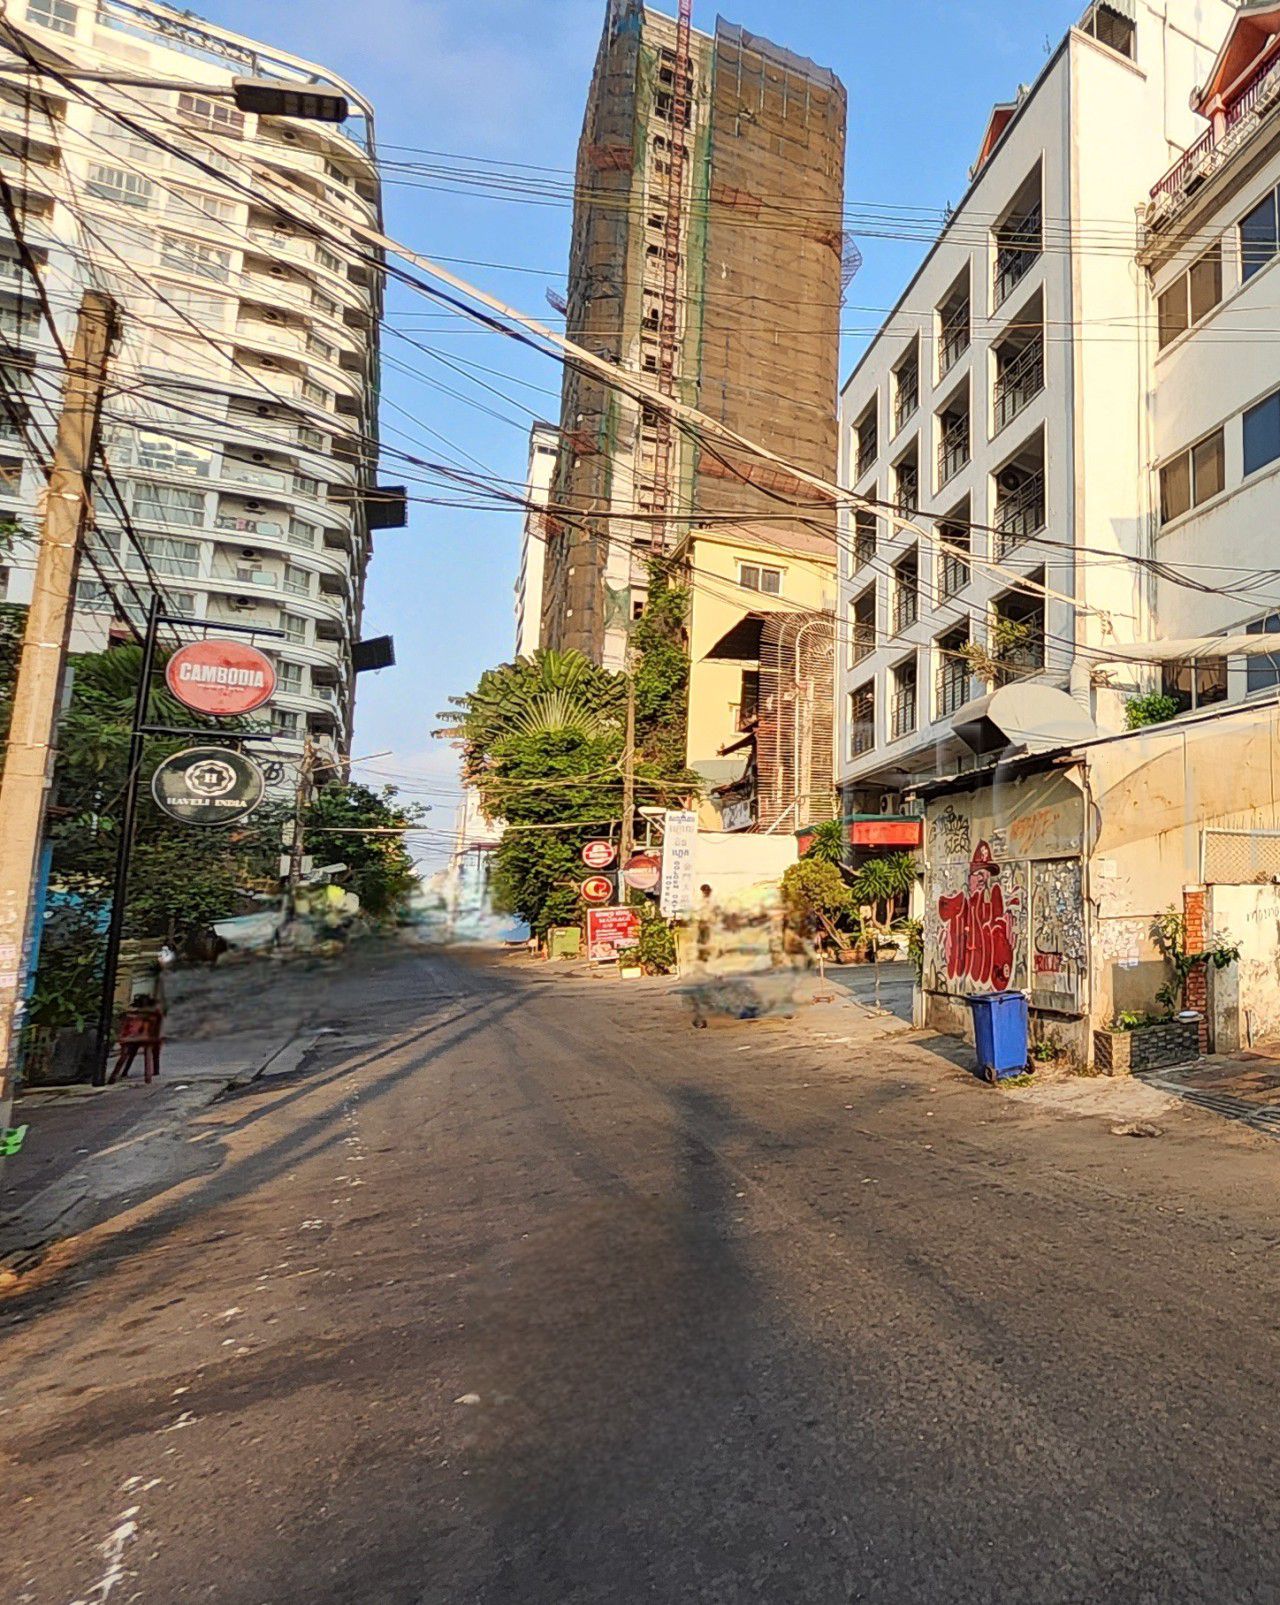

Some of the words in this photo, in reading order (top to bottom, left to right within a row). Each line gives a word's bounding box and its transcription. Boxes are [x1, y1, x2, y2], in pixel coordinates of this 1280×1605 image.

[179, 662, 265, 688] CAMBODIA
[166, 797, 211, 806] HAVELI
[214, 799, 248, 808] INDIA
